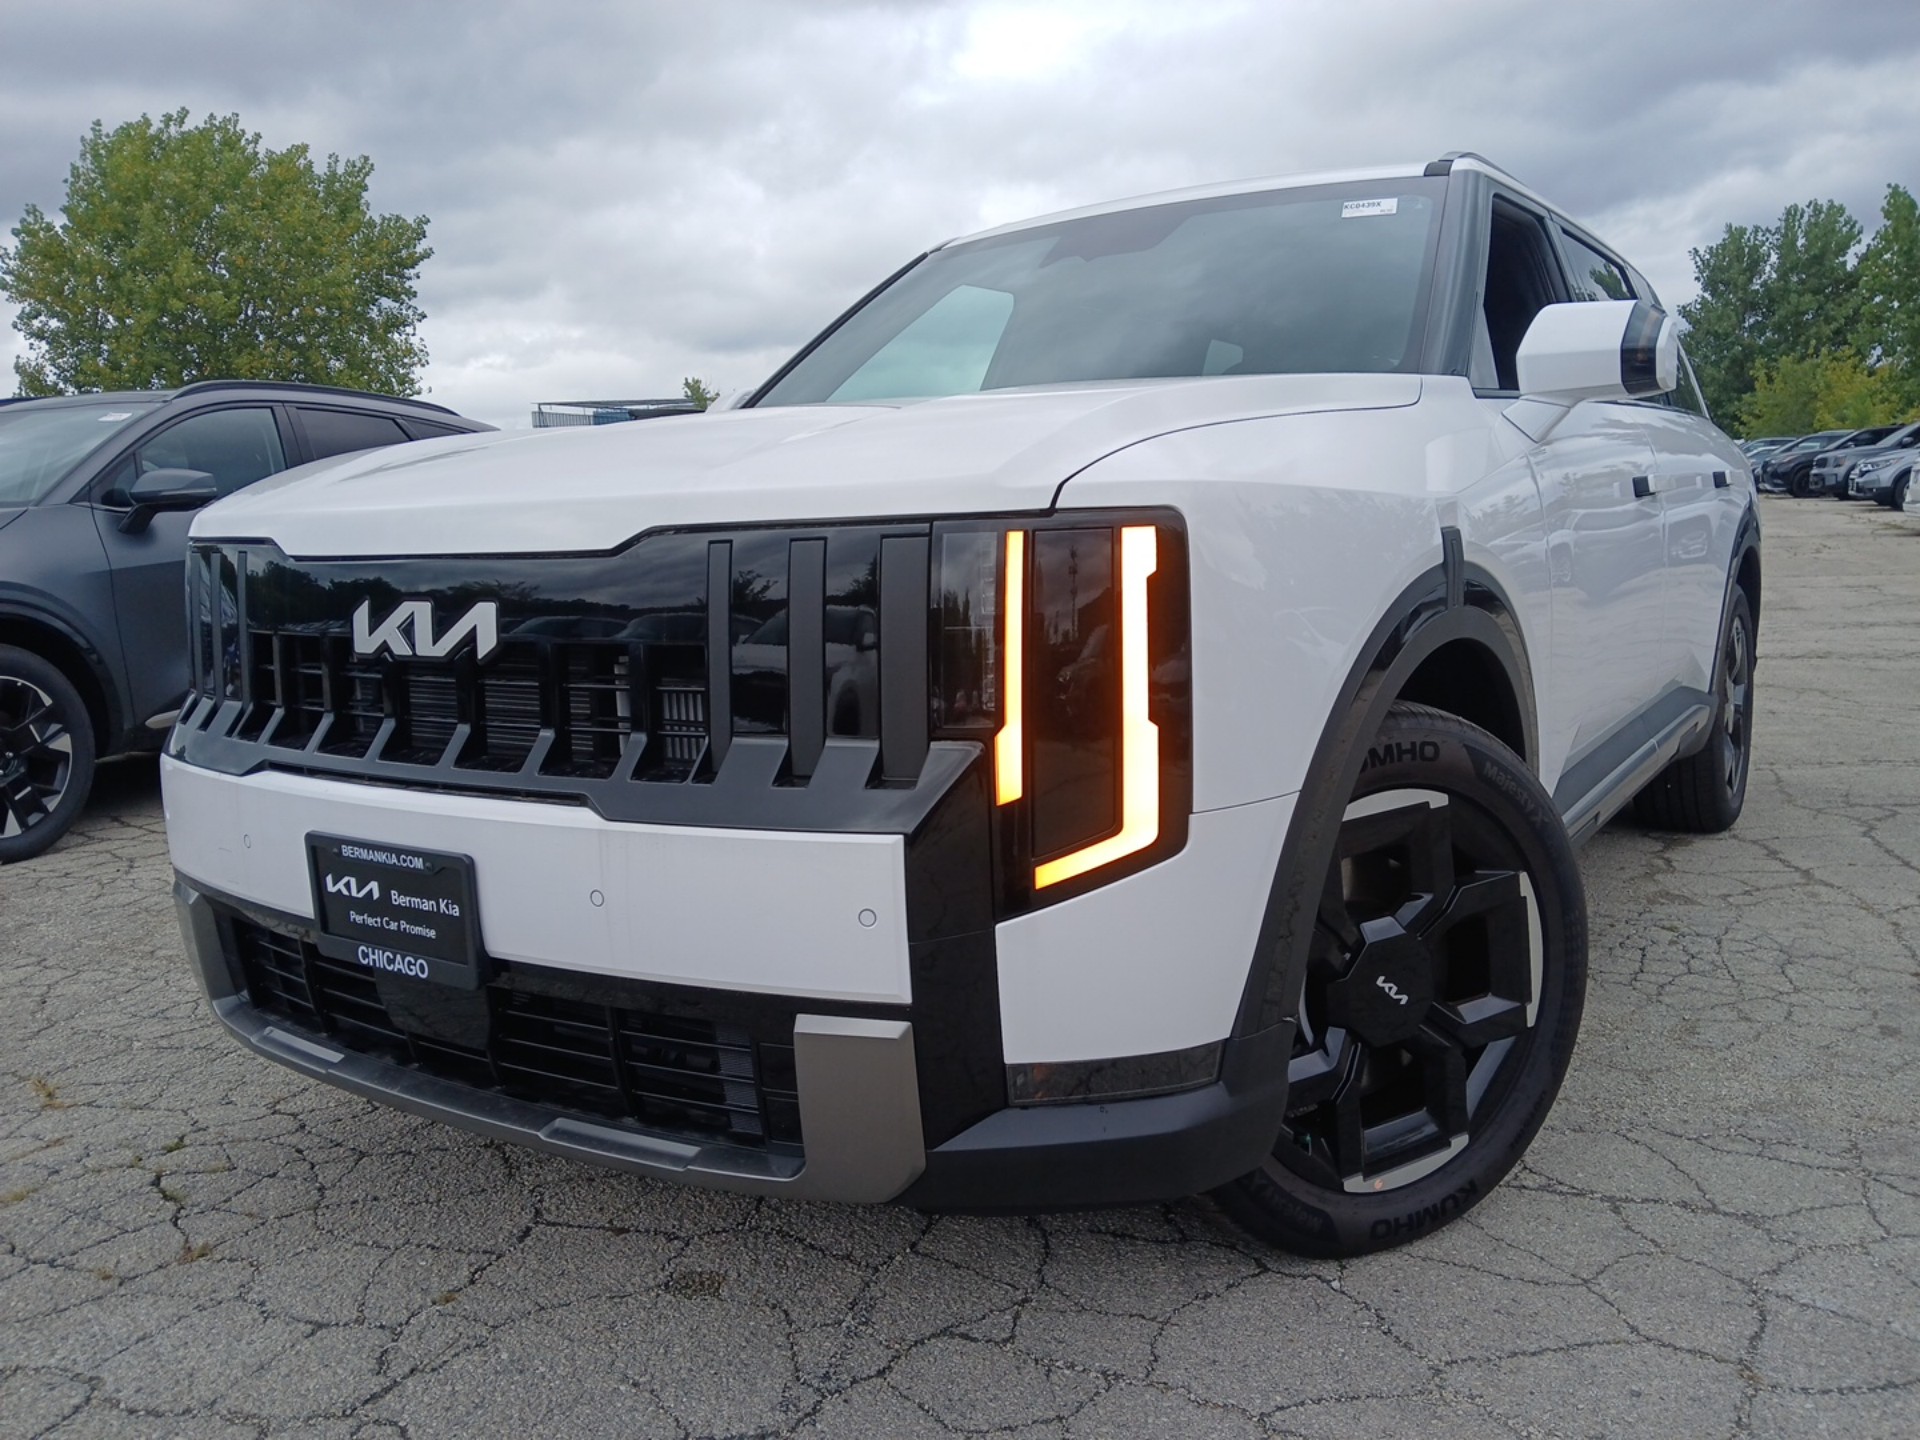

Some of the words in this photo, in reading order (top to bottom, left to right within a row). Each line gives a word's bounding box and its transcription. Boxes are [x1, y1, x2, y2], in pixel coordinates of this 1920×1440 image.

[353, 599, 497, 660] KIA
[1360, 741, 1440, 773] MHO
[341, 845, 424, 870] BERMANKIA.COM
[325, 873, 380, 900] KIA
[390, 890, 437, 912] Berman
[439, 898, 460, 916] Kia
[350, 910, 381, 927] Perfect
[382, 916, 398, 931] Car
[400, 920, 436, 939] Promise
[358, 945, 428, 979] CHICAGO
[1376, 976, 1408, 1005] KIA
[1369, 1179, 1478, 1241] KUMHO
